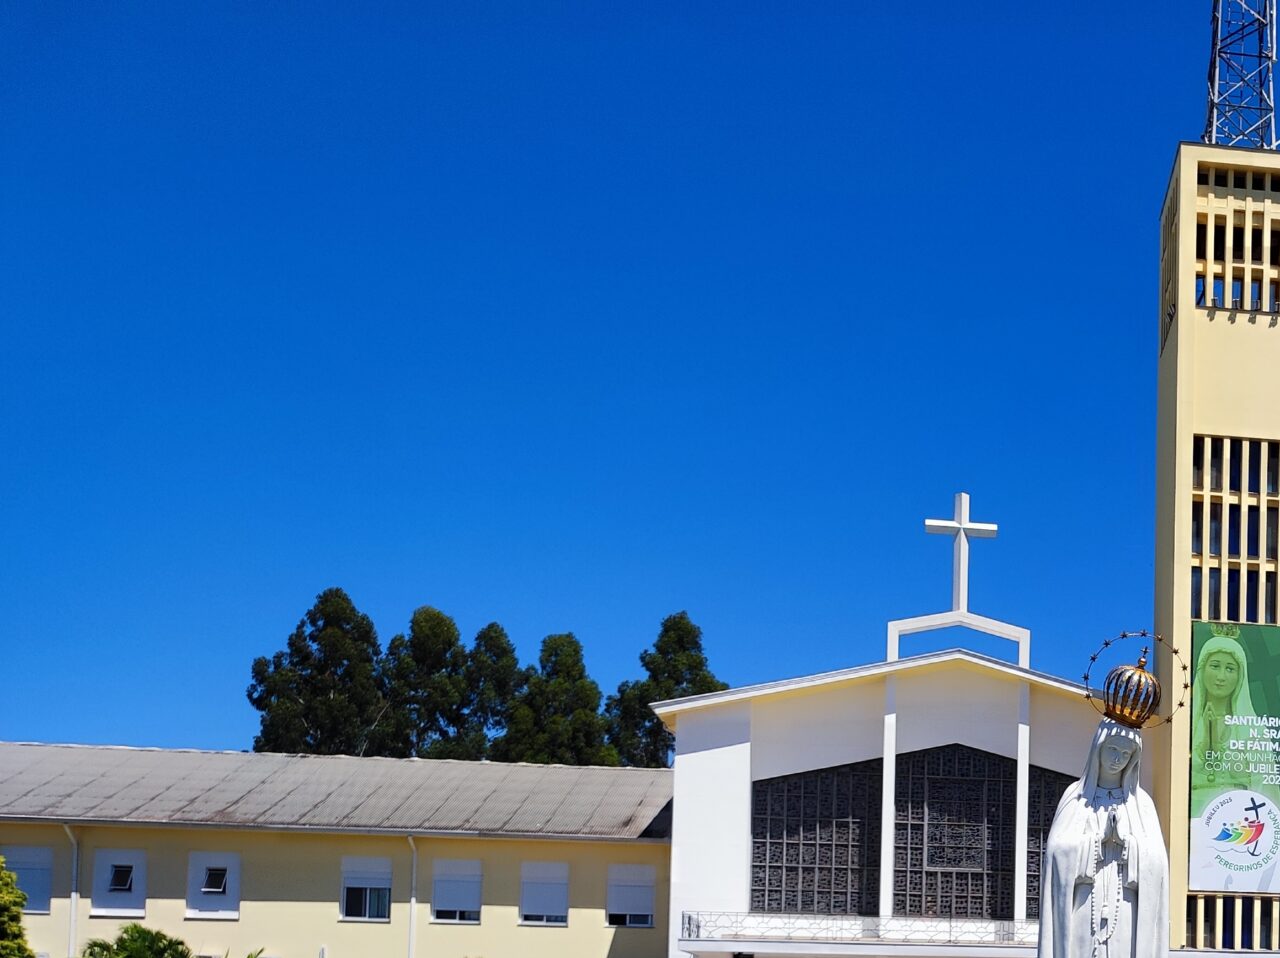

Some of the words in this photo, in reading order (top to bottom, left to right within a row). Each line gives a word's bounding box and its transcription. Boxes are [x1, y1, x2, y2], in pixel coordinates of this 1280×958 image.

[1250, 728, 1260, 738] N.
[1230, 740, 1245, 750] DE
[1206, 751, 1220, 760] EM
[1205, 762, 1231, 771] COM
[1234, 762, 1243, 772] O
[1205, 805, 1220, 827] JUBILEU
[1267, 809, 1280, 855] ESPERANÇA
[1215, 854, 1262, 872] PEREGRINOS
[1262, 855, 1273, 865] DE
